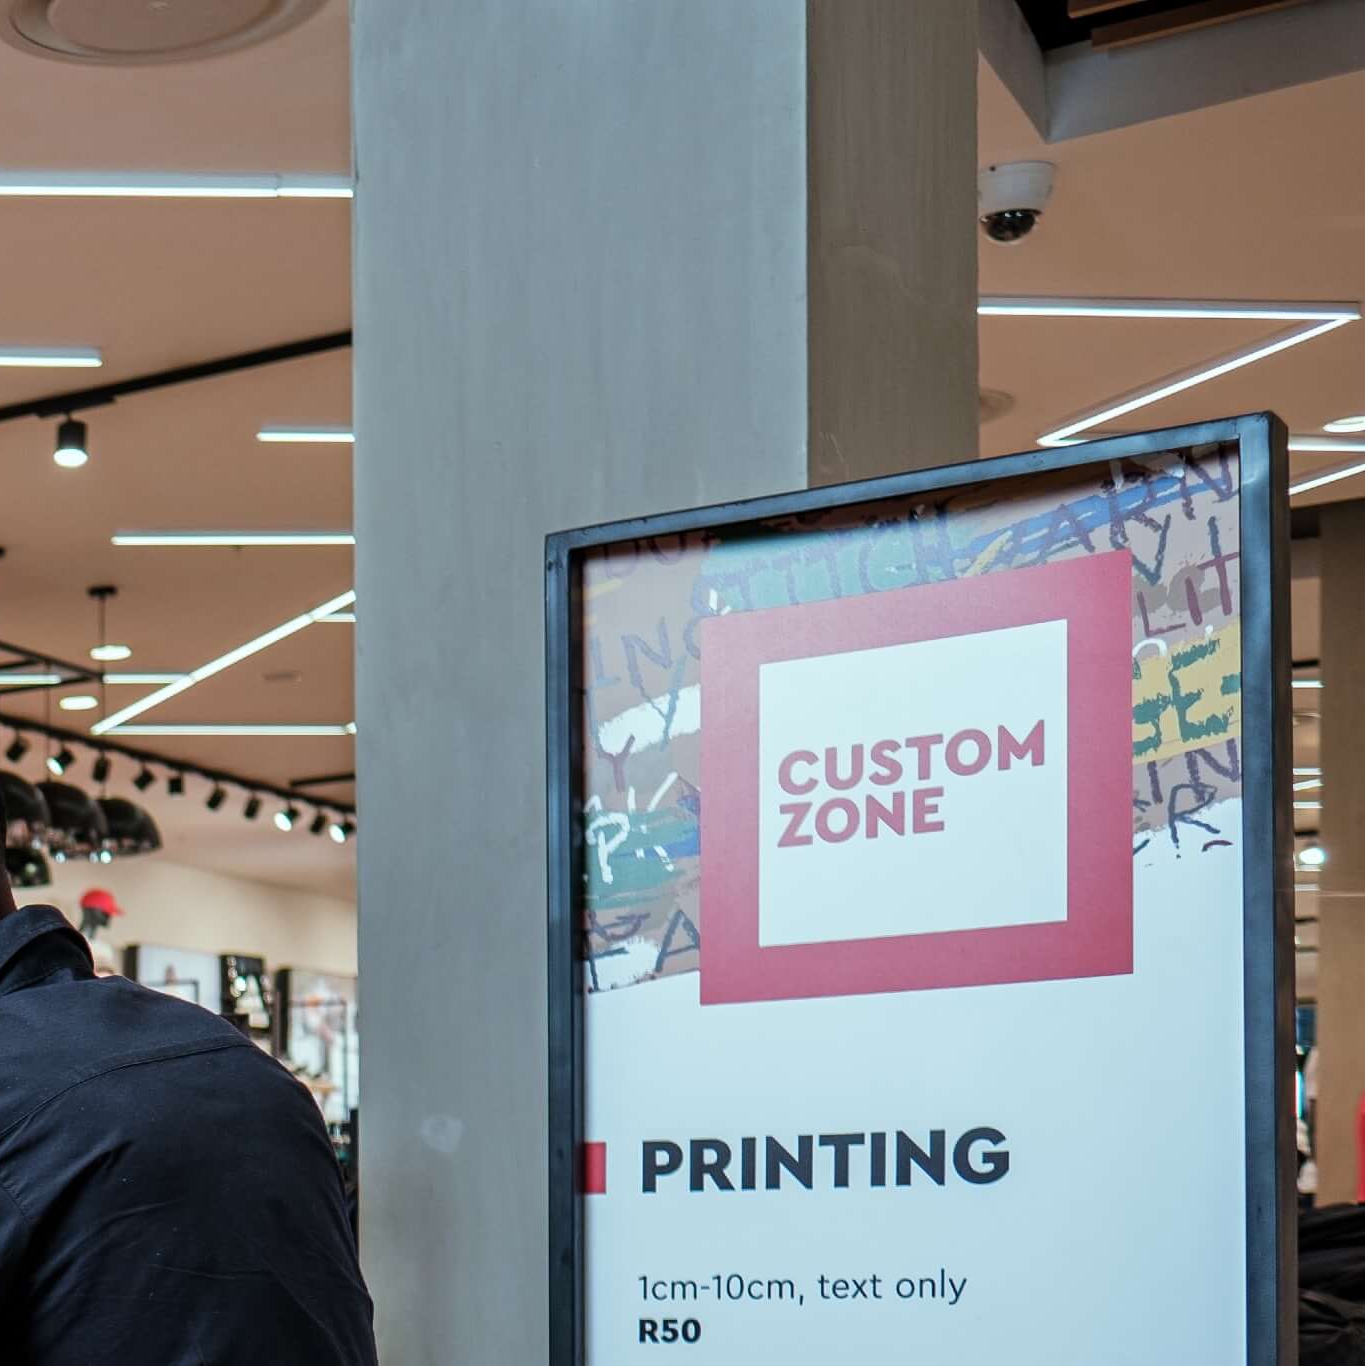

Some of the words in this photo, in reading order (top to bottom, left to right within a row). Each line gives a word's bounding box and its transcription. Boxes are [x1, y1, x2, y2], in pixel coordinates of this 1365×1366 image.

[777, 719, 1045, 796] CUSTOM
[777, 786, 945, 848] ZONE
[642, 1126, 1010, 1194] PRINTING
[638, 1273, 804, 1306] 1cm-10cm,
[817, 1274, 883, 1300] text
[896, 1268, 967, 1305] only
[638, 1316, 701, 1344] R50
